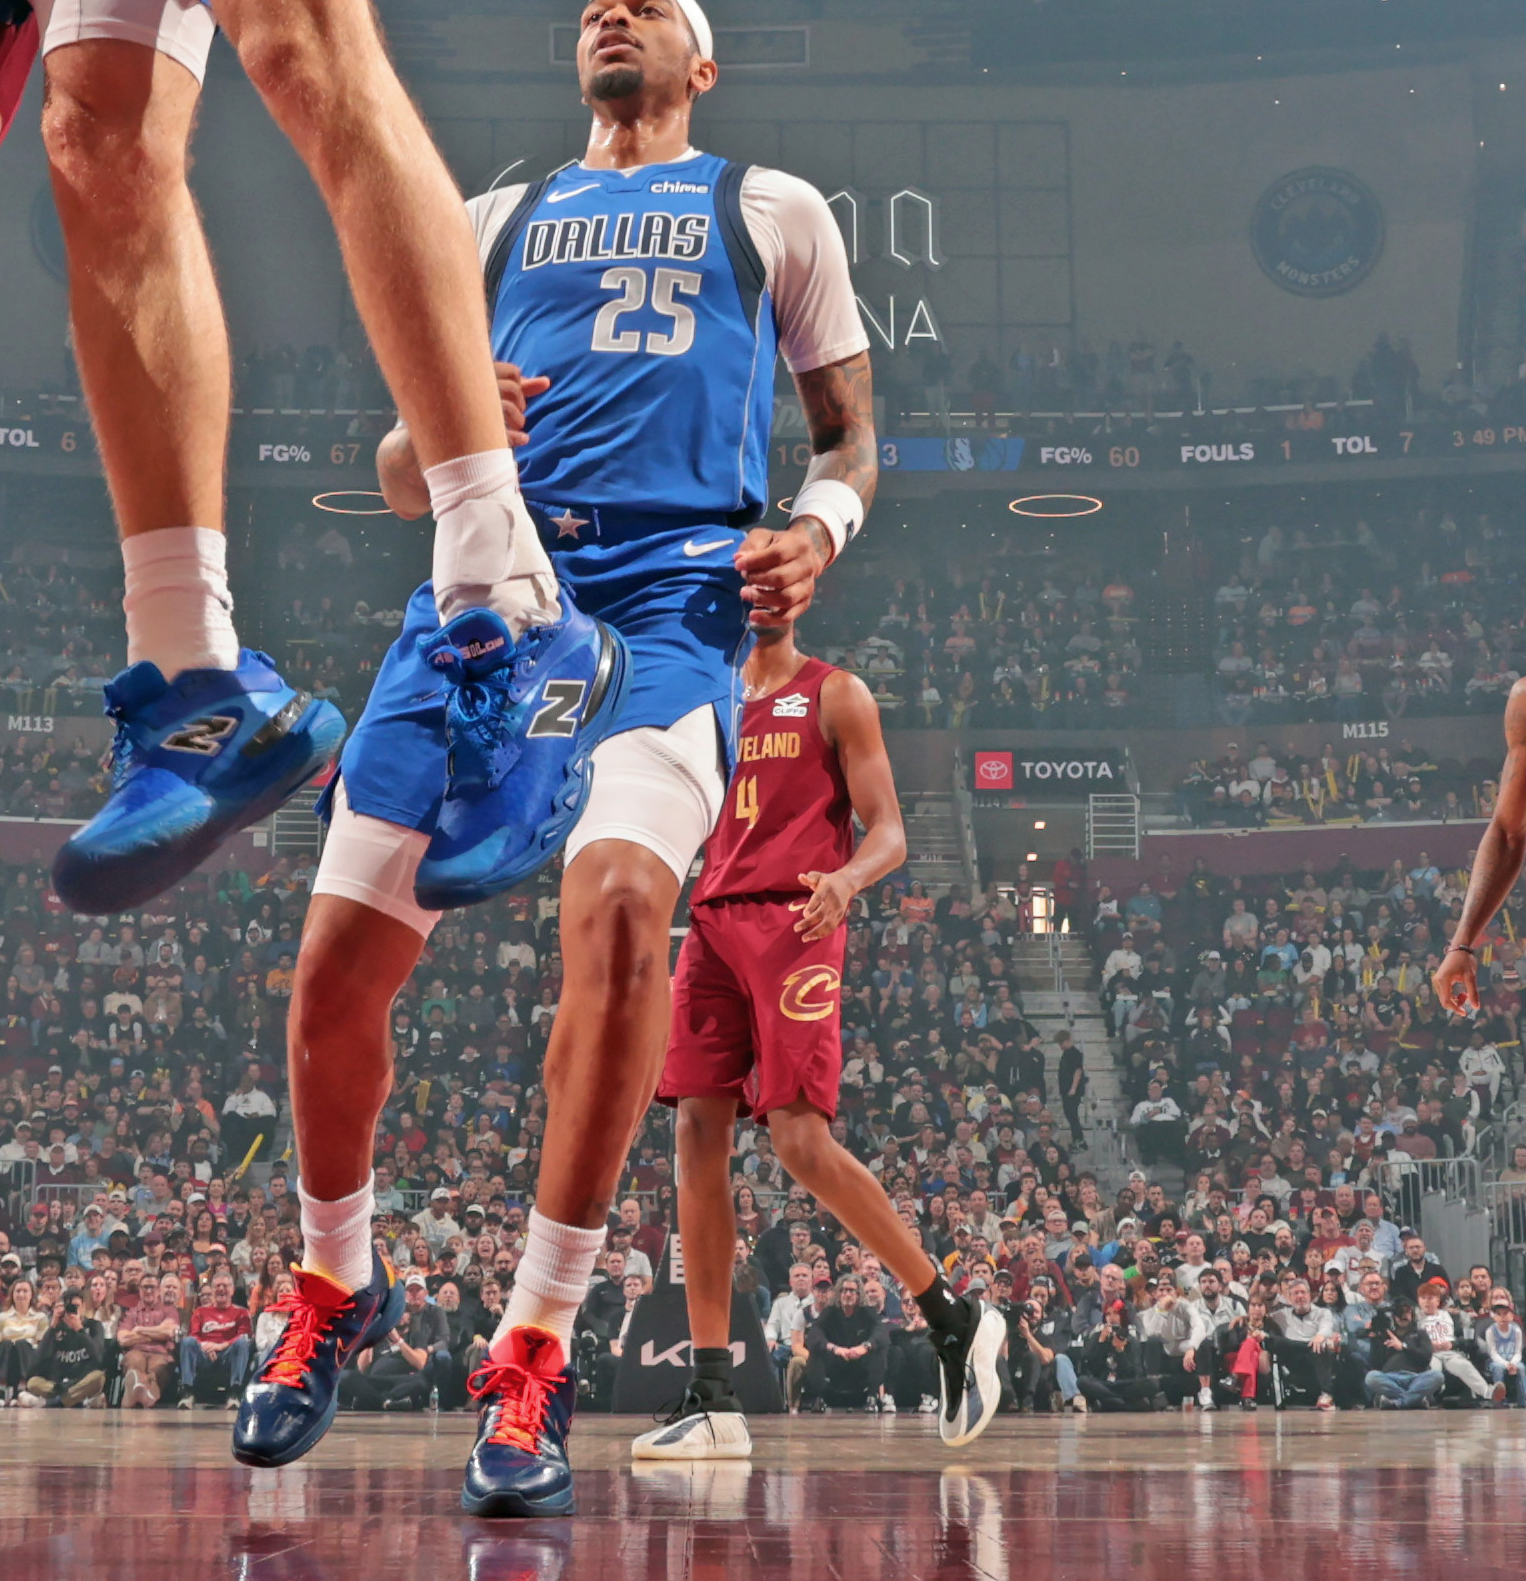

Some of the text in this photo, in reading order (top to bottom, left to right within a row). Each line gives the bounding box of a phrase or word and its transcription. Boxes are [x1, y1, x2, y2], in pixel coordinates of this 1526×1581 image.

[650, 180, 709, 195] chime
[522, 212, 709, 271] DALLAS
[1276, 255, 1360, 286] MONSTERS
[591, 267, 701, 355] 25
[61, 432, 77, 452] 6
[882, 444, 898, 466] 3
[1041, 446, 1092, 465] FG%
[1109, 446, 1140, 467] 60
[1181, 442, 1255, 463] FOULS
[1332, 436, 1377, 454] TOL
[1399, 432, 1413, 453] 7
[259, 443, 360, 464] FG% 67
[774, 708, 804, 716] CLIFFS
[7, 715, 54, 733] M113
[1343, 722, 1389, 739] M115
[736, 732, 801, 763] VELAND
[1021, 761, 1114, 779] TOYOTA
[735, 775, 759, 830] 4
